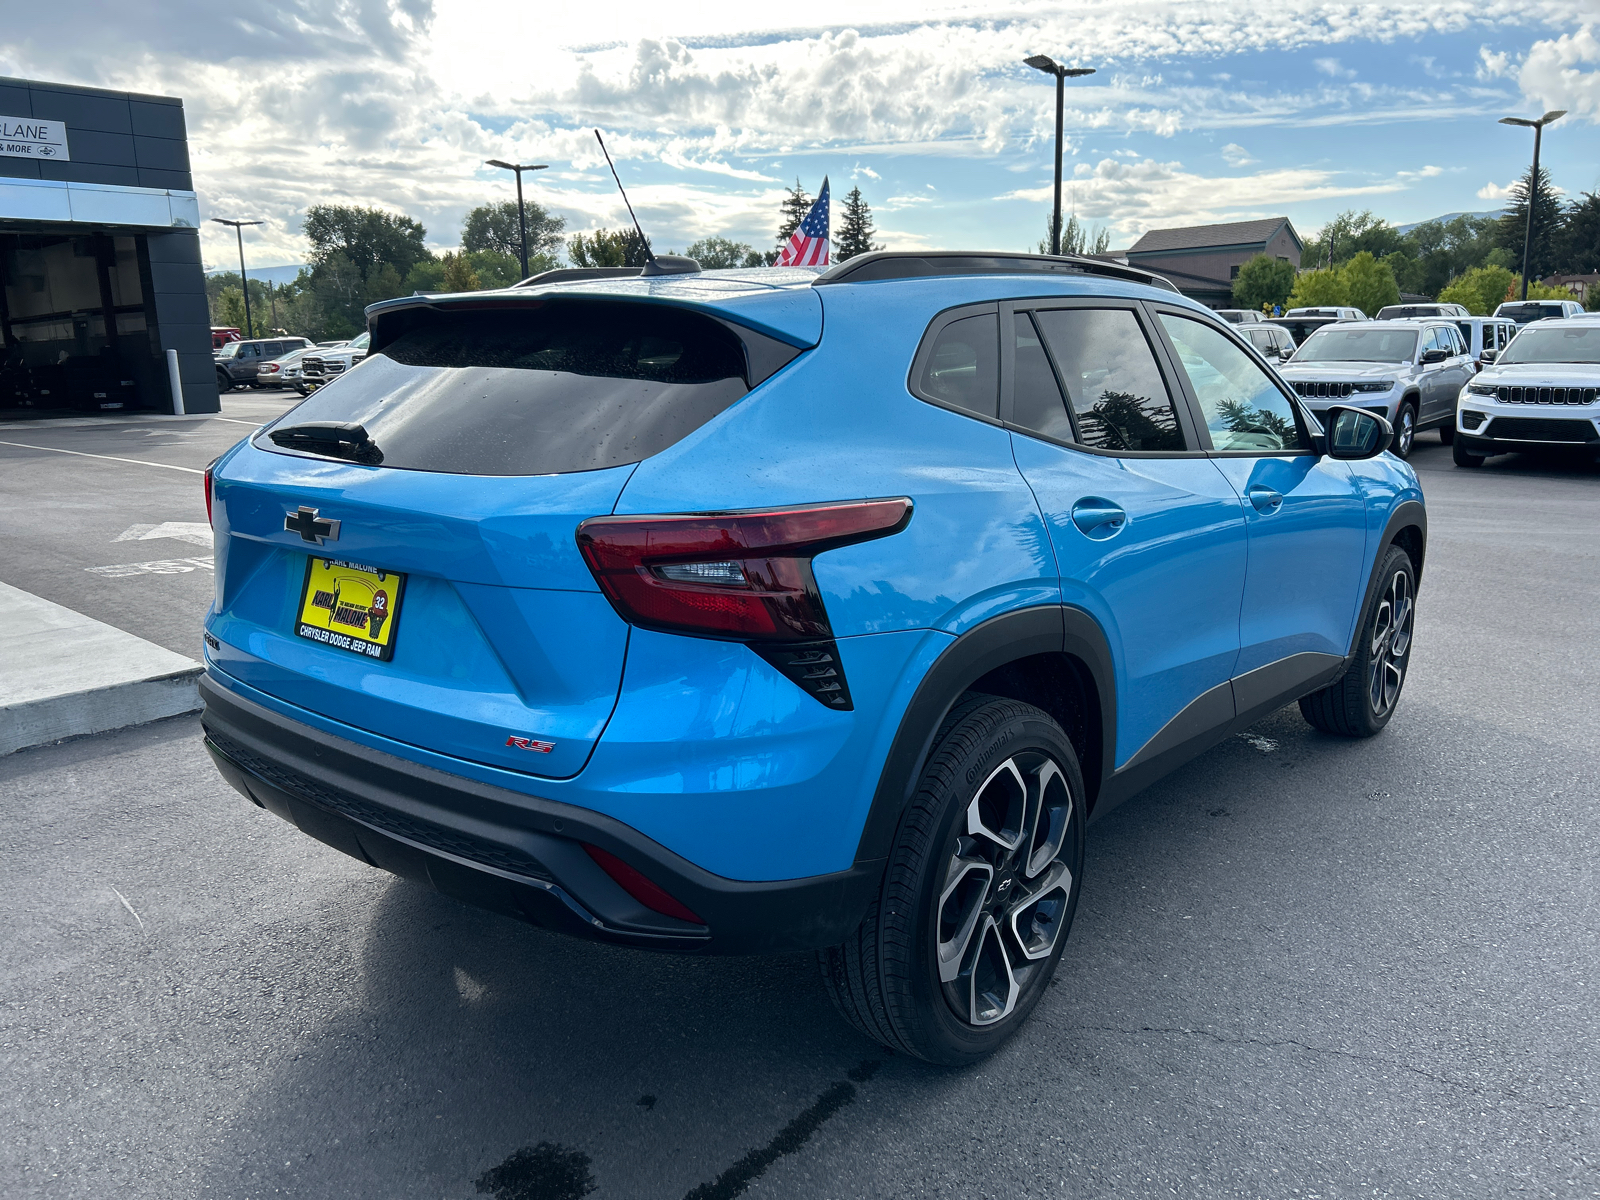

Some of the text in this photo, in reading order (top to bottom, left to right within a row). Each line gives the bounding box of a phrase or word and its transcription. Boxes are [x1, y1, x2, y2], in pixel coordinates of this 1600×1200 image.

[0, 122, 48, 140] LANE
[6, 144, 32, 154] MORE
[311, 590, 334, 610] KARL
[374, 596, 386, 610] 32
[333, 606, 369, 630] MALONE
[300, 625, 382, 658] CHRYSLER DODGE JEEP RAM
[505, 735, 557, 754] RS
[965, 730, 1009, 786] Continental
